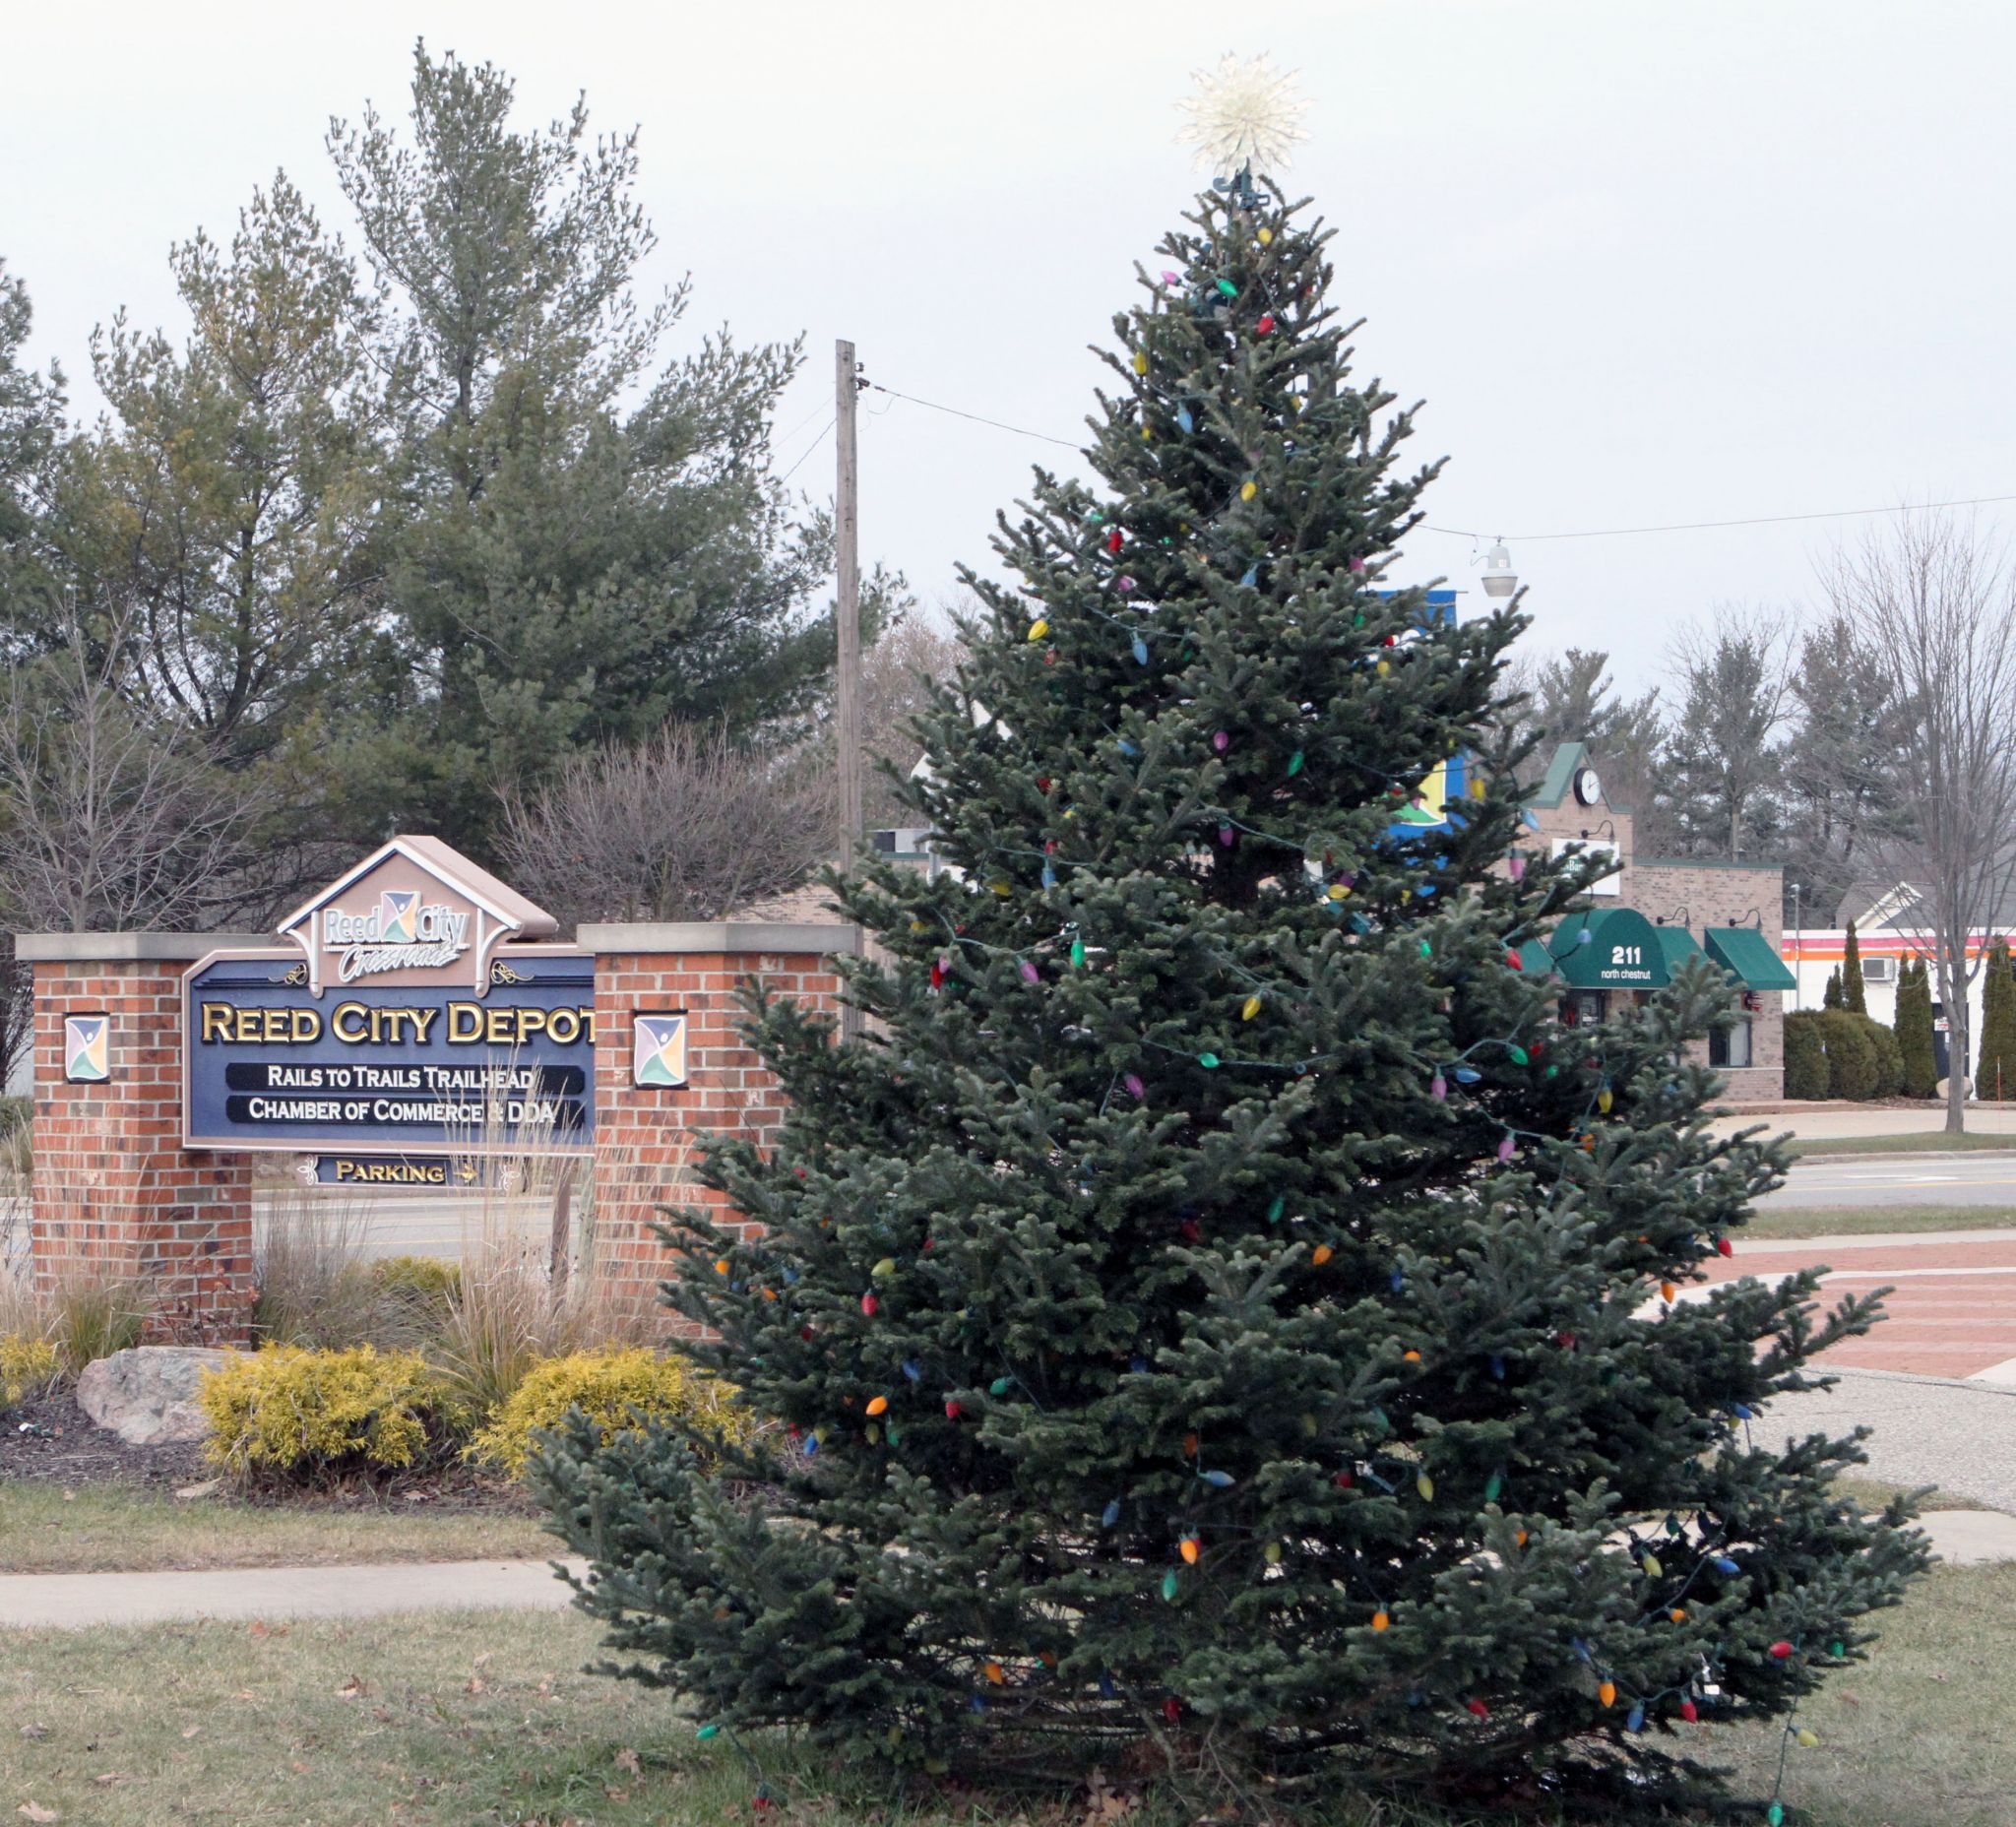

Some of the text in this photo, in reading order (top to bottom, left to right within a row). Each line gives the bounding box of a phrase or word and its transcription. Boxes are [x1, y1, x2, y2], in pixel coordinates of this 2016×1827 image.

[325, 904, 470, 945] Reed City
[339, 941, 462, 982] Crossroads
[1611, 946, 1641, 964] 211
[1602, 969, 1651, 979] north chestnut
[201, 1002, 322, 1043] REED
[332, 1002, 438, 1043] CITY
[268, 1065, 535, 1090] RAILS TO TRAILS TRAILHEAD
[249, 1098, 342, 1120] CHAMBER
[345, 1102, 370, 1120] OF
[374, 1099, 483, 1122] COMMERCE
[508, 1102, 556, 1124] DDA
[336, 1161, 445, 1182] PARKING
